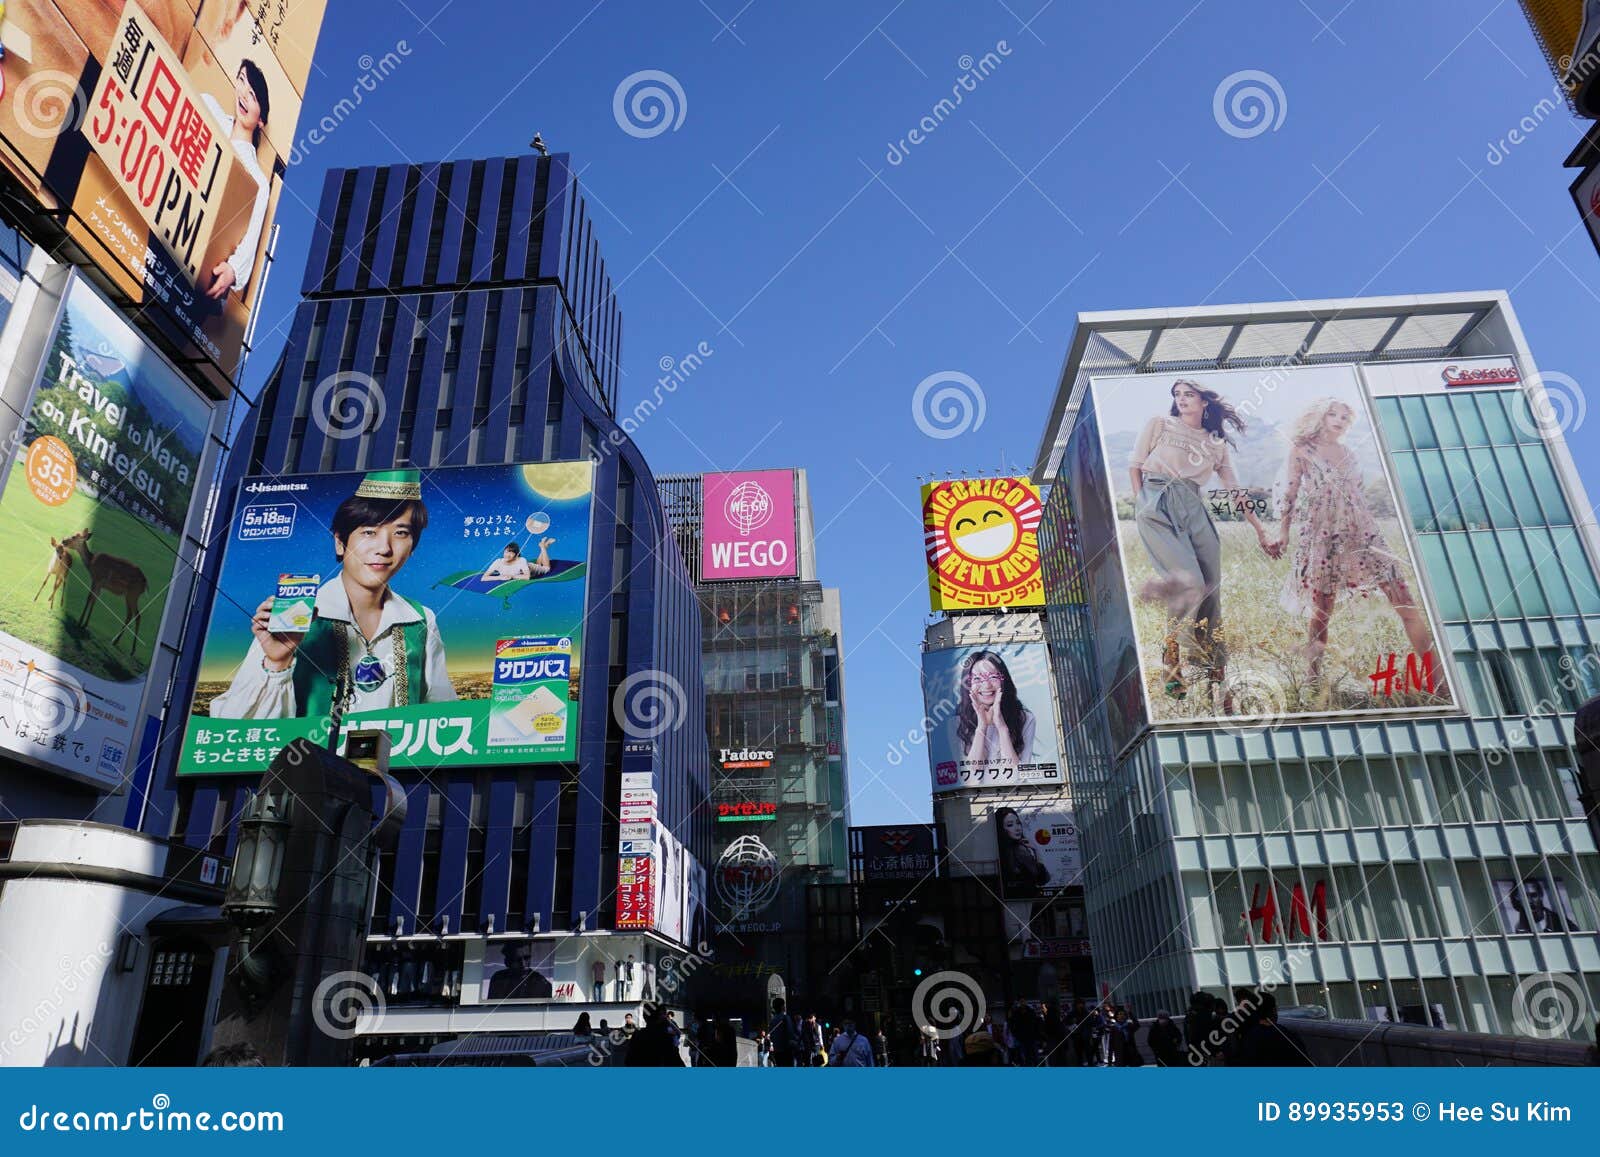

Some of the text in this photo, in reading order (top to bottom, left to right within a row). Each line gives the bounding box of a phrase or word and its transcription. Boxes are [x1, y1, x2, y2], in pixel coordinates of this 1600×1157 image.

[59, 350, 128, 432] Travel
[127, 424, 143, 446] to
[144, 429, 191, 486] Nara
[41, 399, 65, 428] on
[67, 407, 165, 506] Kintetsu.
[37, 455, 65, 487] 35
[924, 479, 1025, 527] NICONICO
[1208, 489, 1249, 500] ブラウス
[1210, 499, 1267, 517] ¥1,499
[711, 540, 788, 568] WEGO
[939, 532, 1039, 586] RENTACAR
[932, 577, 1042, 606] ニコニコレンタカ
[498, 659, 568, 679] サロンパス
[1368, 651, 1435, 697] H&M
[328, 717, 474, 757] サンパス
[719, 748, 774, 764] J'adore
[960, 768, 1014, 783] ワクワク
